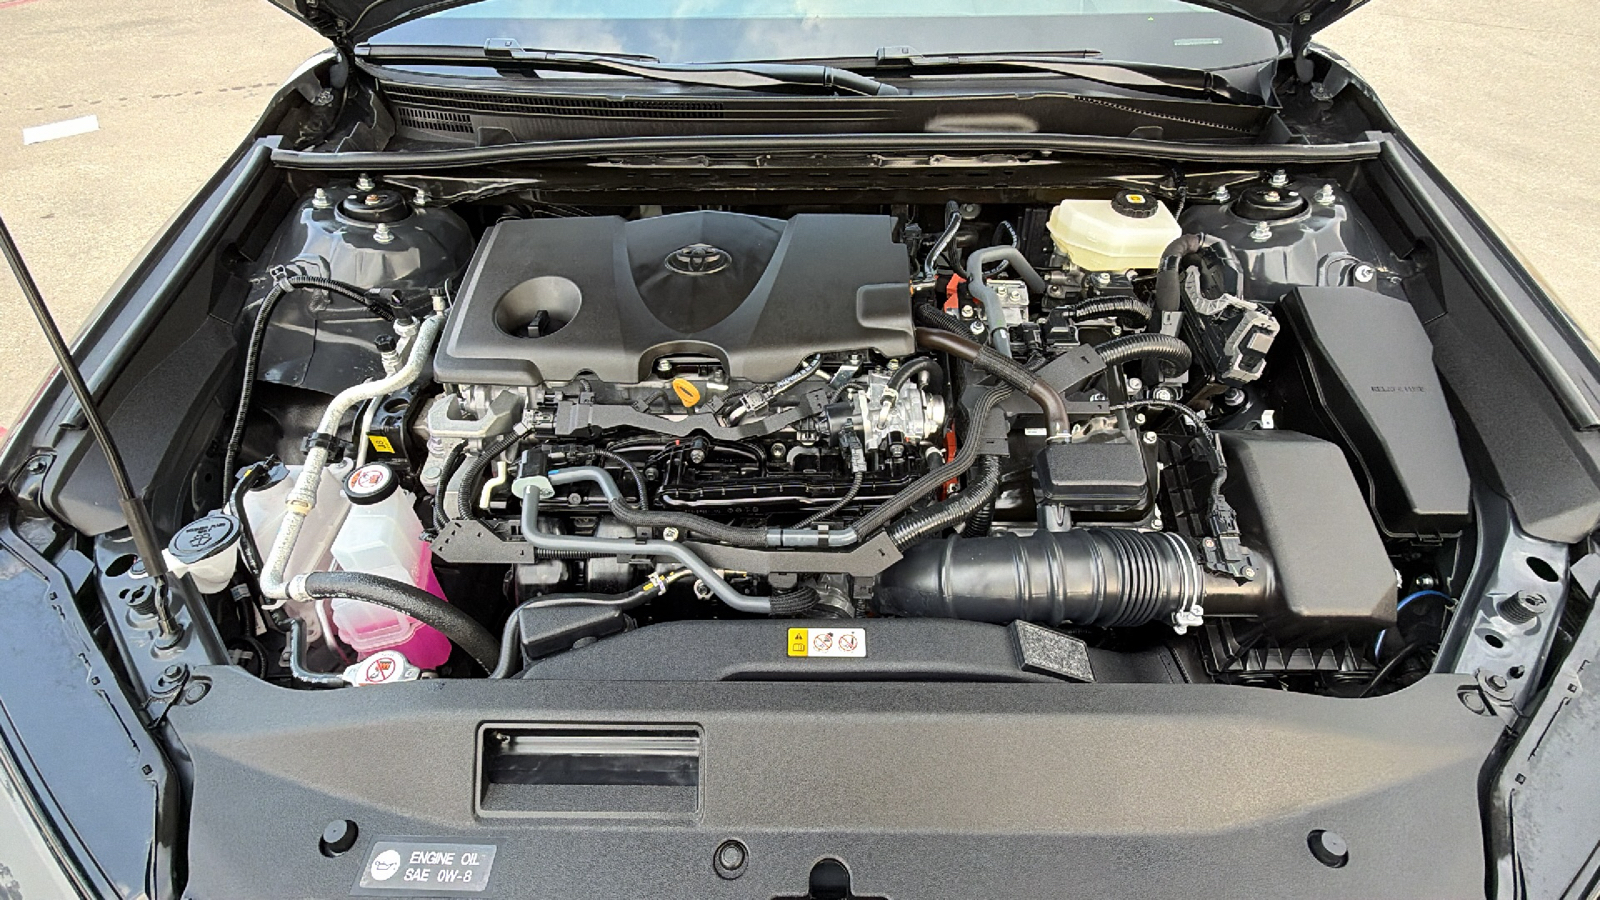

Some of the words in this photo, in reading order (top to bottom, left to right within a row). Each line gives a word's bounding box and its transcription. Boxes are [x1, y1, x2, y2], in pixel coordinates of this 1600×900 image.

[409, 851, 455, 866] ENGINE
[460, 852, 480, 866] OIL
[403, 868, 431, 882] SAE
[436, 869, 473, 882] 0W-8
